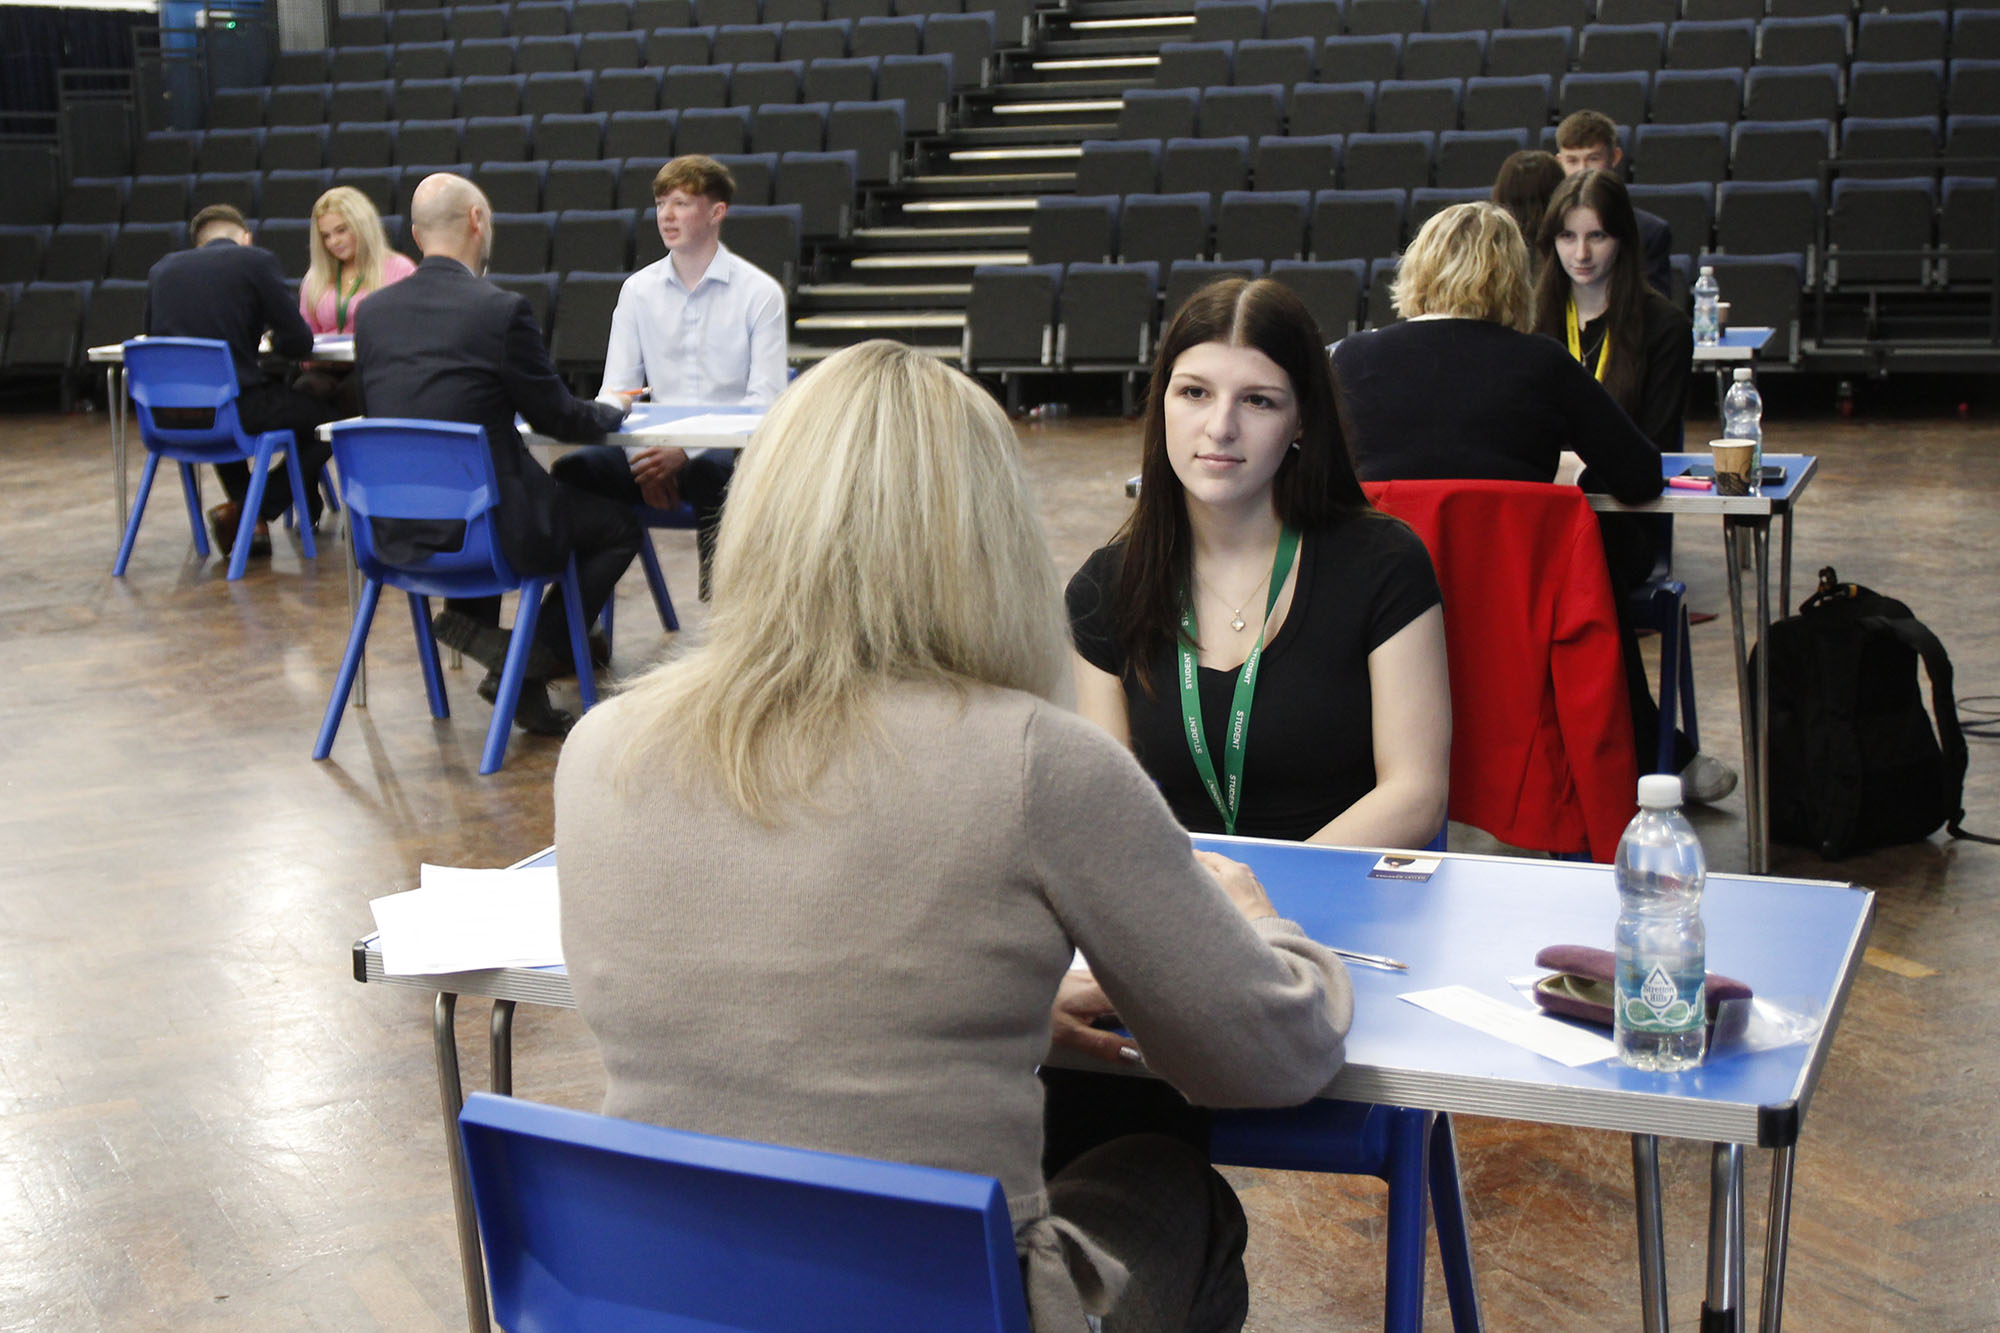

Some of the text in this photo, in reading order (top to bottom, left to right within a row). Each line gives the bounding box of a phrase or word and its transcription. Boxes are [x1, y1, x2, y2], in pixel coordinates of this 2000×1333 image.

[1184, 652, 1193, 690] STUDENT
[1188, 716, 1202, 754] STUDENT
[1232, 710, 1244, 750] STUDENT
[1228, 774, 1237, 811] STUDENT
